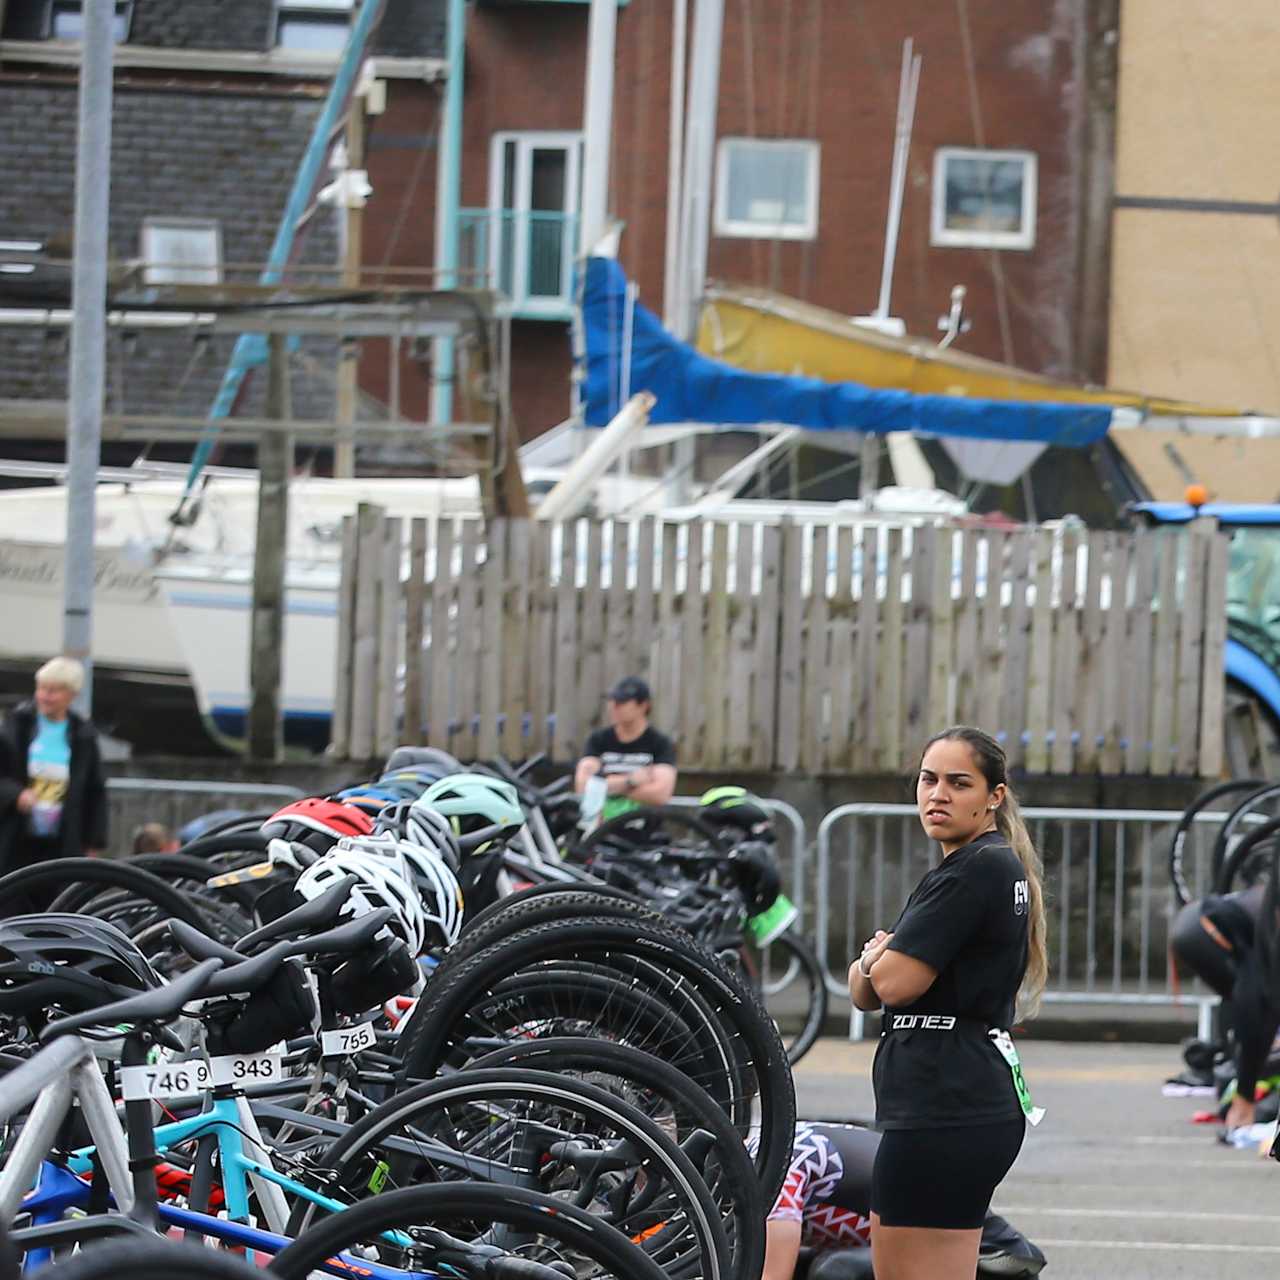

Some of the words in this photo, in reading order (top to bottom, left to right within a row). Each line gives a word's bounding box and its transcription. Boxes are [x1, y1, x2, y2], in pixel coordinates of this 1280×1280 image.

[28, 960, 55, 975] dhb
[340, 1029, 370, 1050] 755
[232, 1060, 273, 1079] 343
[146, 1072, 190, 1093] 746
